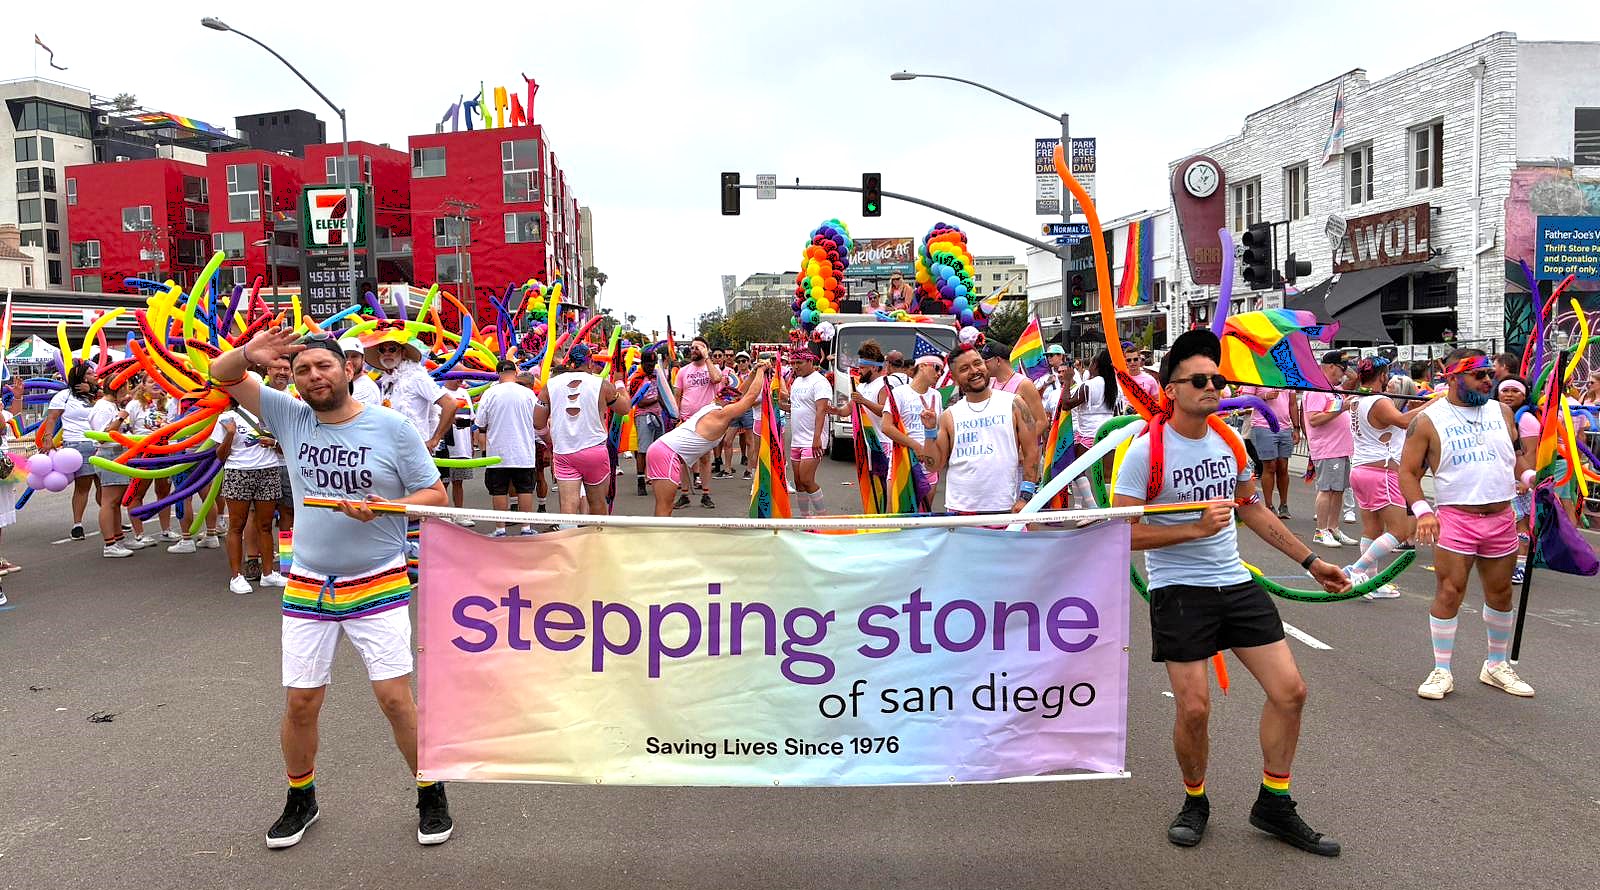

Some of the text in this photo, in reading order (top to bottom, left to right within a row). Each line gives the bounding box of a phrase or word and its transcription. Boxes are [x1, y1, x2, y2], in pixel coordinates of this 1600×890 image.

[1073, 141, 1094, 149] PARK
[1036, 149, 1053, 157] FRE
[1036, 156, 1054, 164] @TH
[1073, 149, 1094, 157] FREE
[1073, 163, 1094, 172] DMV
[316, 219, 353, 230] ELEVE
[1335, 214, 1428, 264] AWOL
[1544, 230, 1572, 239] Father
[1572, 230, 1594, 239] Joe's
[849, 244, 892, 265] URIOUS
[1544, 244, 1567, 252] Thrift
[1568, 244, 1590, 252] Store
[1544, 254, 1598, 263] and Donation
[1543, 265, 1598, 275] Drop off only.
[956, 415, 1006, 431] PROTECT
[957, 432, 978, 444] THE
[1449, 436, 1477, 451] THE
[298, 442, 372, 468] PROTECT
[956, 444, 994, 458] DOLLS
[1452, 450, 1497, 465] DOLLS
[1172, 455, 1232, 488] PROTECT
[300, 466, 314, 478] THE
[316, 468, 373, 494] DOLLS
[1177, 477, 1236, 502] THE DOLLS
[451, 583, 1099, 685] stepping stone
[818, 671, 1097, 719] of san diego
[646, 736, 900, 758] Saving Lives Since 1976
